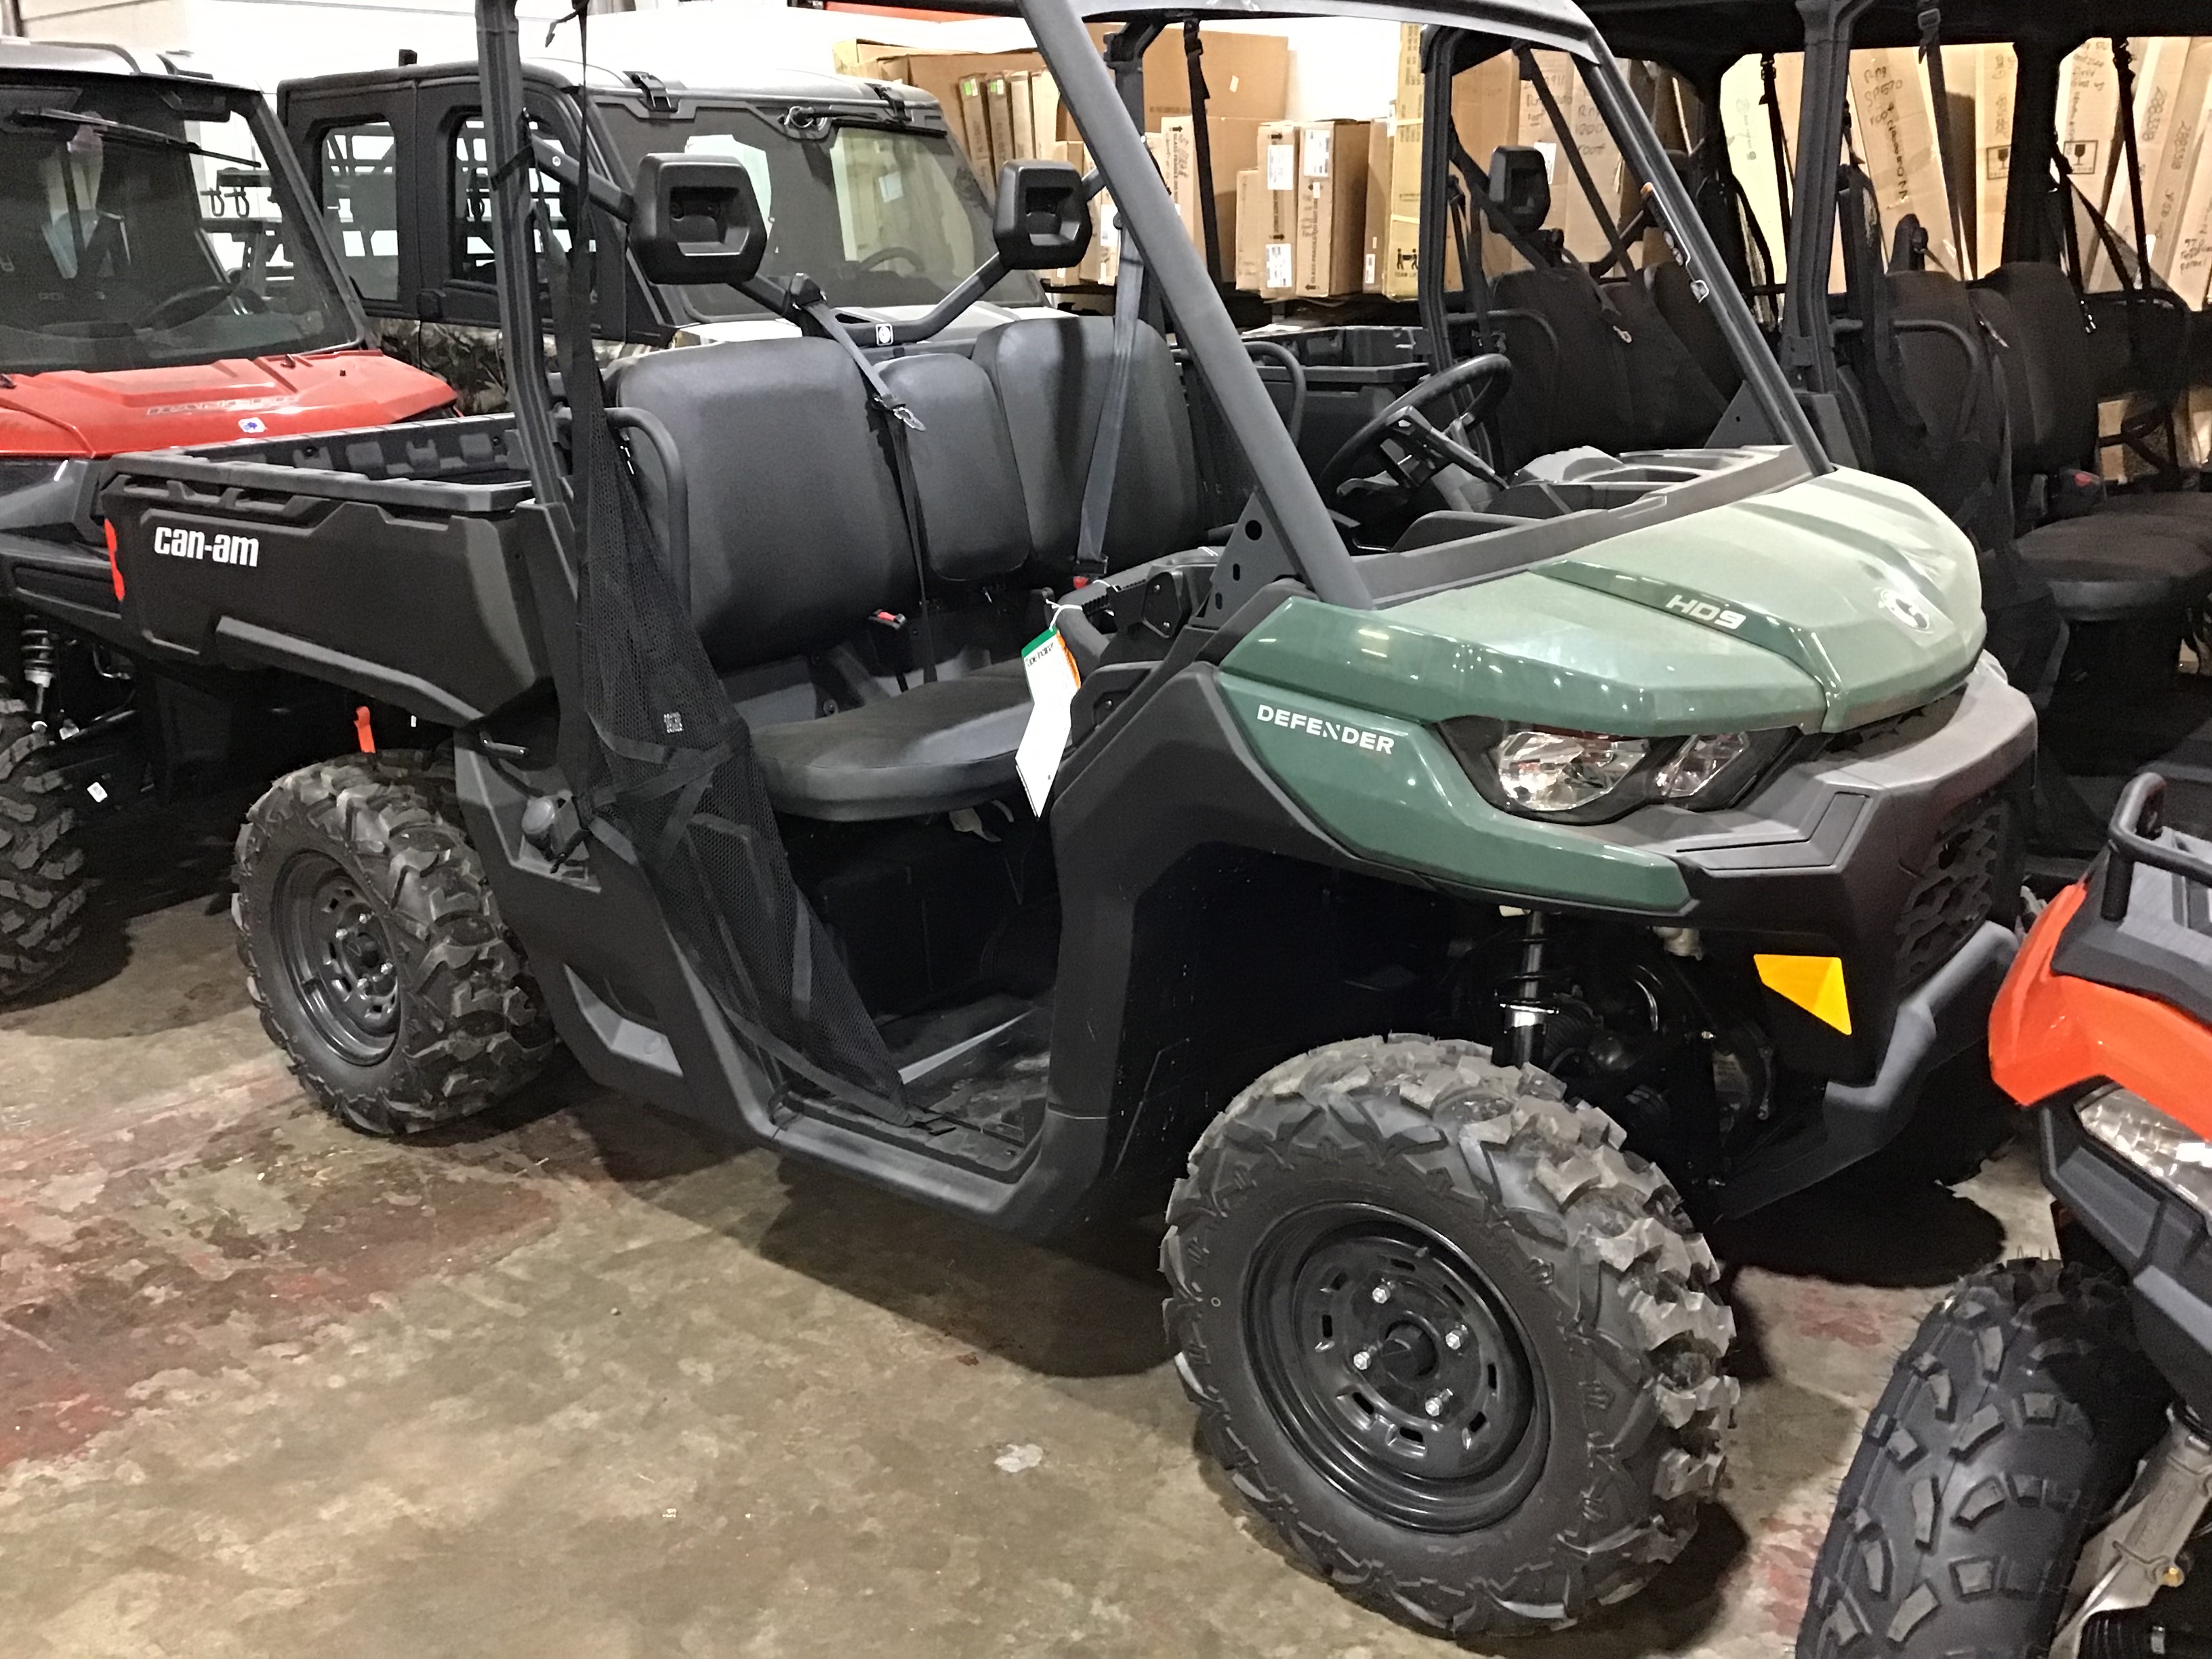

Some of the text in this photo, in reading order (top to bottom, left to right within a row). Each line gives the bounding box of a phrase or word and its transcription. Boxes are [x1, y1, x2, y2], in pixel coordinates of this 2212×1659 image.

[154, 526, 260, 567] can-am
[1665, 594, 1746, 630] HD9
[1256, 703, 1395, 754] DEFENDER
